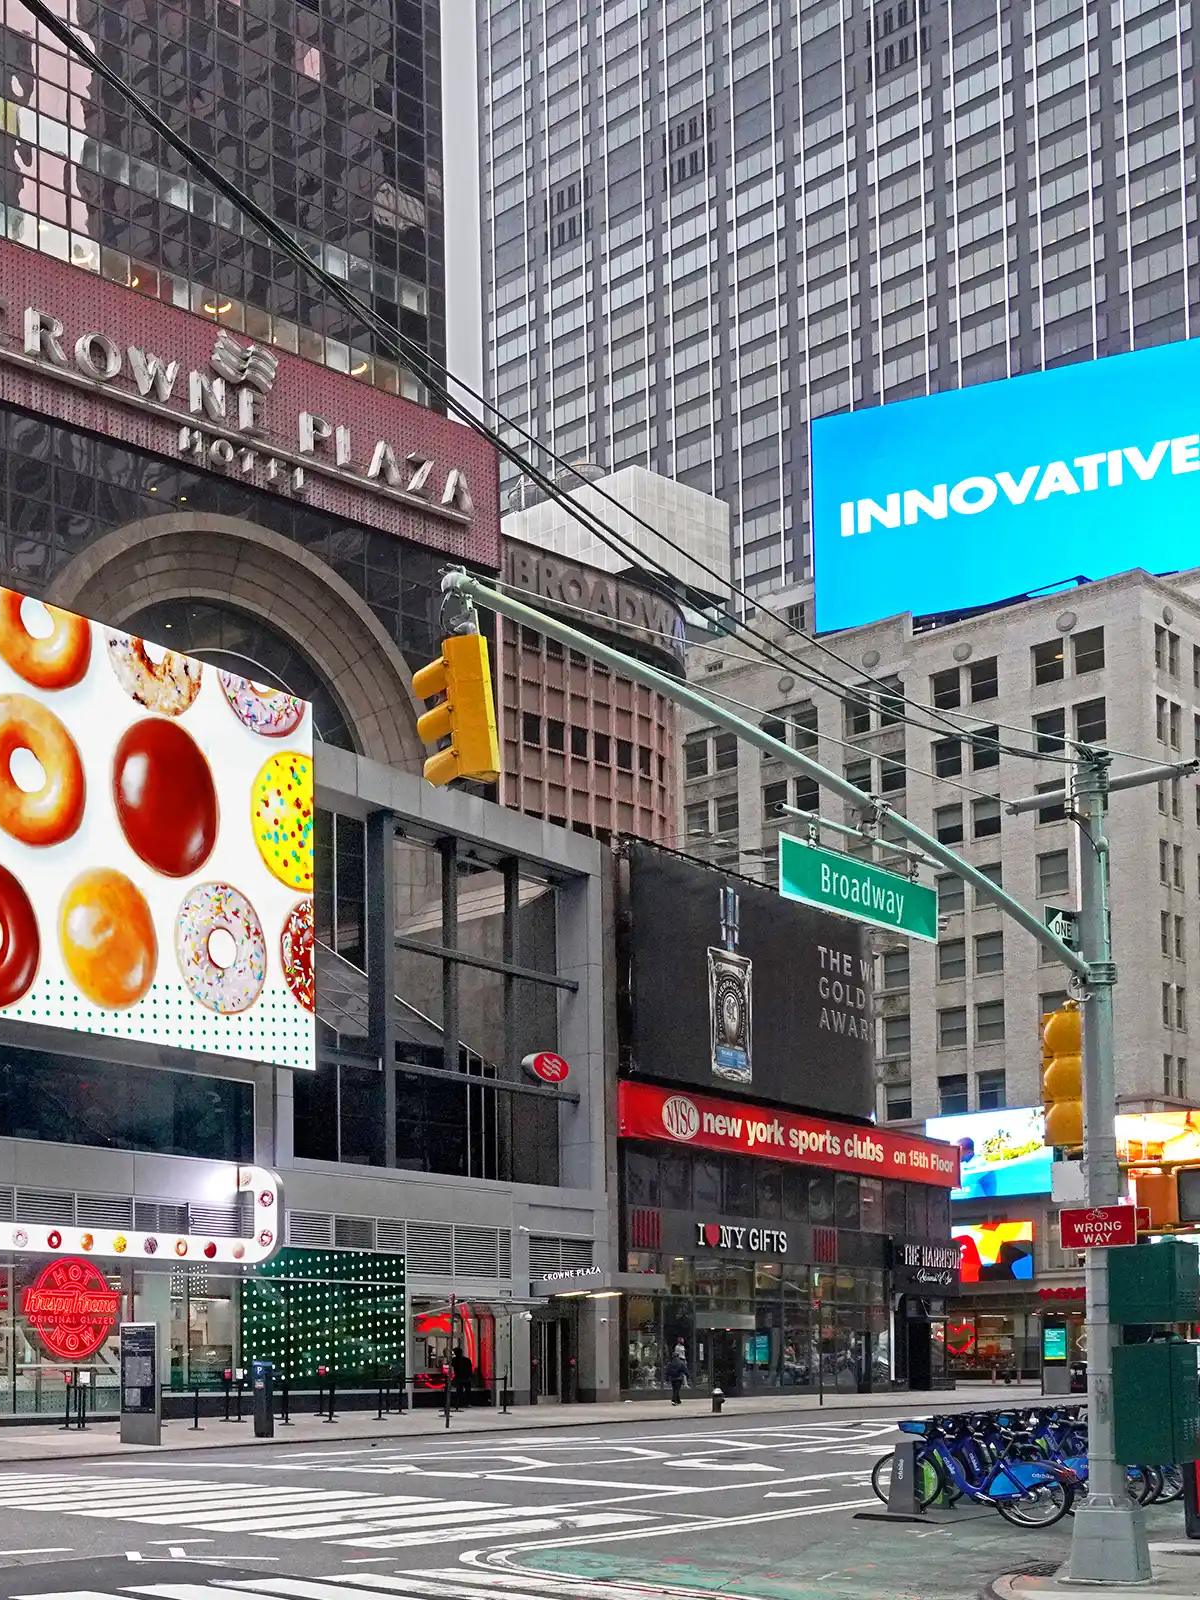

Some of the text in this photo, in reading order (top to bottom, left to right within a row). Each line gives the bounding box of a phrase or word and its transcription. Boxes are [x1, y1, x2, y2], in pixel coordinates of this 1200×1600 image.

[178, 426, 308, 493] HOTEL
[299, 411, 475, 514] PLAZA
[840, 434, 1200, 537] INNOVATIVE
[821, 863, 904, 924] Broadway
[1055, 920, 1072, 938] ONE
[818, 946, 852, 977] THE
[819, 977, 865, 1010] GOLD
[666, 1100, 954, 1173] NYSC new york sports clubs on 15th Floor
[1074, 1221, 1122, 1233] WRONG
[1083, 1232, 1112, 1243] WAY
[749, 1228, 787, 1253] GIFTS
[904, 1244, 962, 1269] THE HARRISON
[52, 1265, 93, 1286] HOT
[542, 1266, 602, 1281] CROWNE PLAZA
[29, 1315, 115, 1325] ORIGINAL GLAZED
[51, 1325, 95, 1350] NOW
[257, 1366, 262, 1375] P
